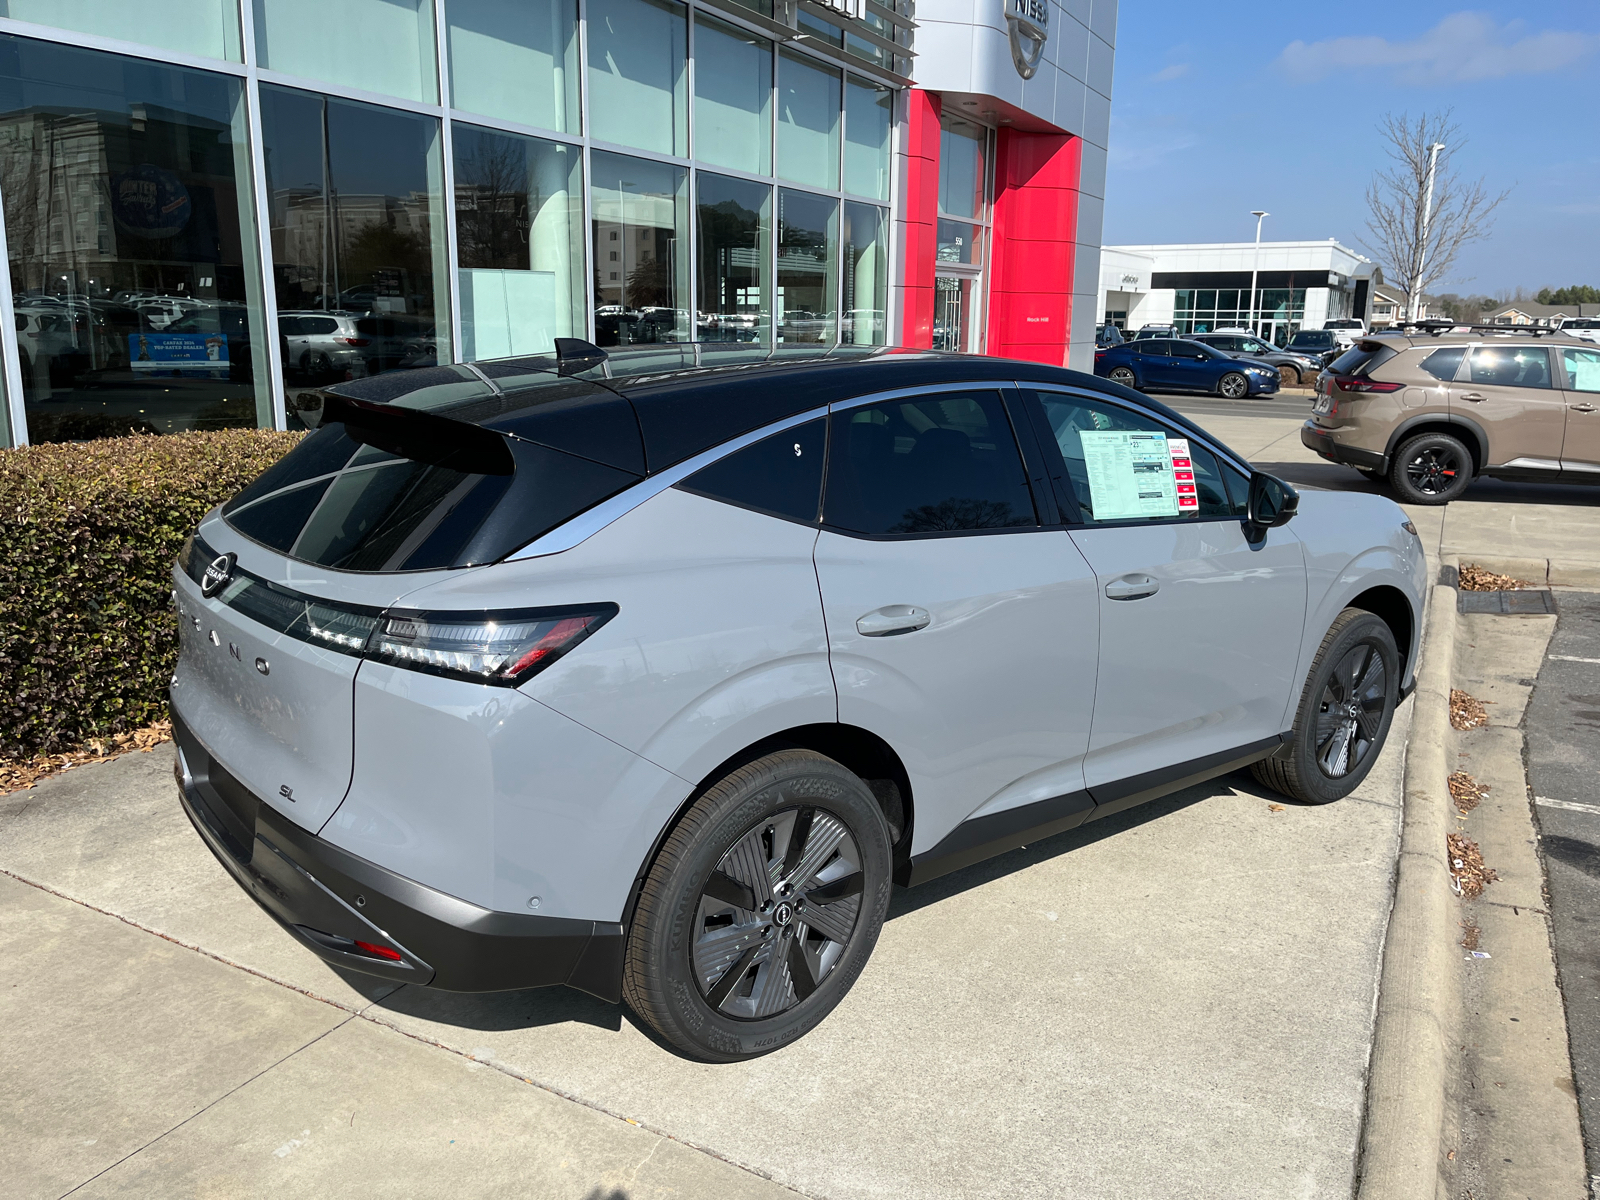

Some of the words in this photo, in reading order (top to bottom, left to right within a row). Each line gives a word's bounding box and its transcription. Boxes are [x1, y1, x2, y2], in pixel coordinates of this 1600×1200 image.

[1015, 0, 1048, 29] NISSA
[279, 784, 296, 803] SL
[671, 870, 701, 953] KUMHO
[781, 1026, 798, 1040] R20
[753, 1038, 777, 1048] 107H
